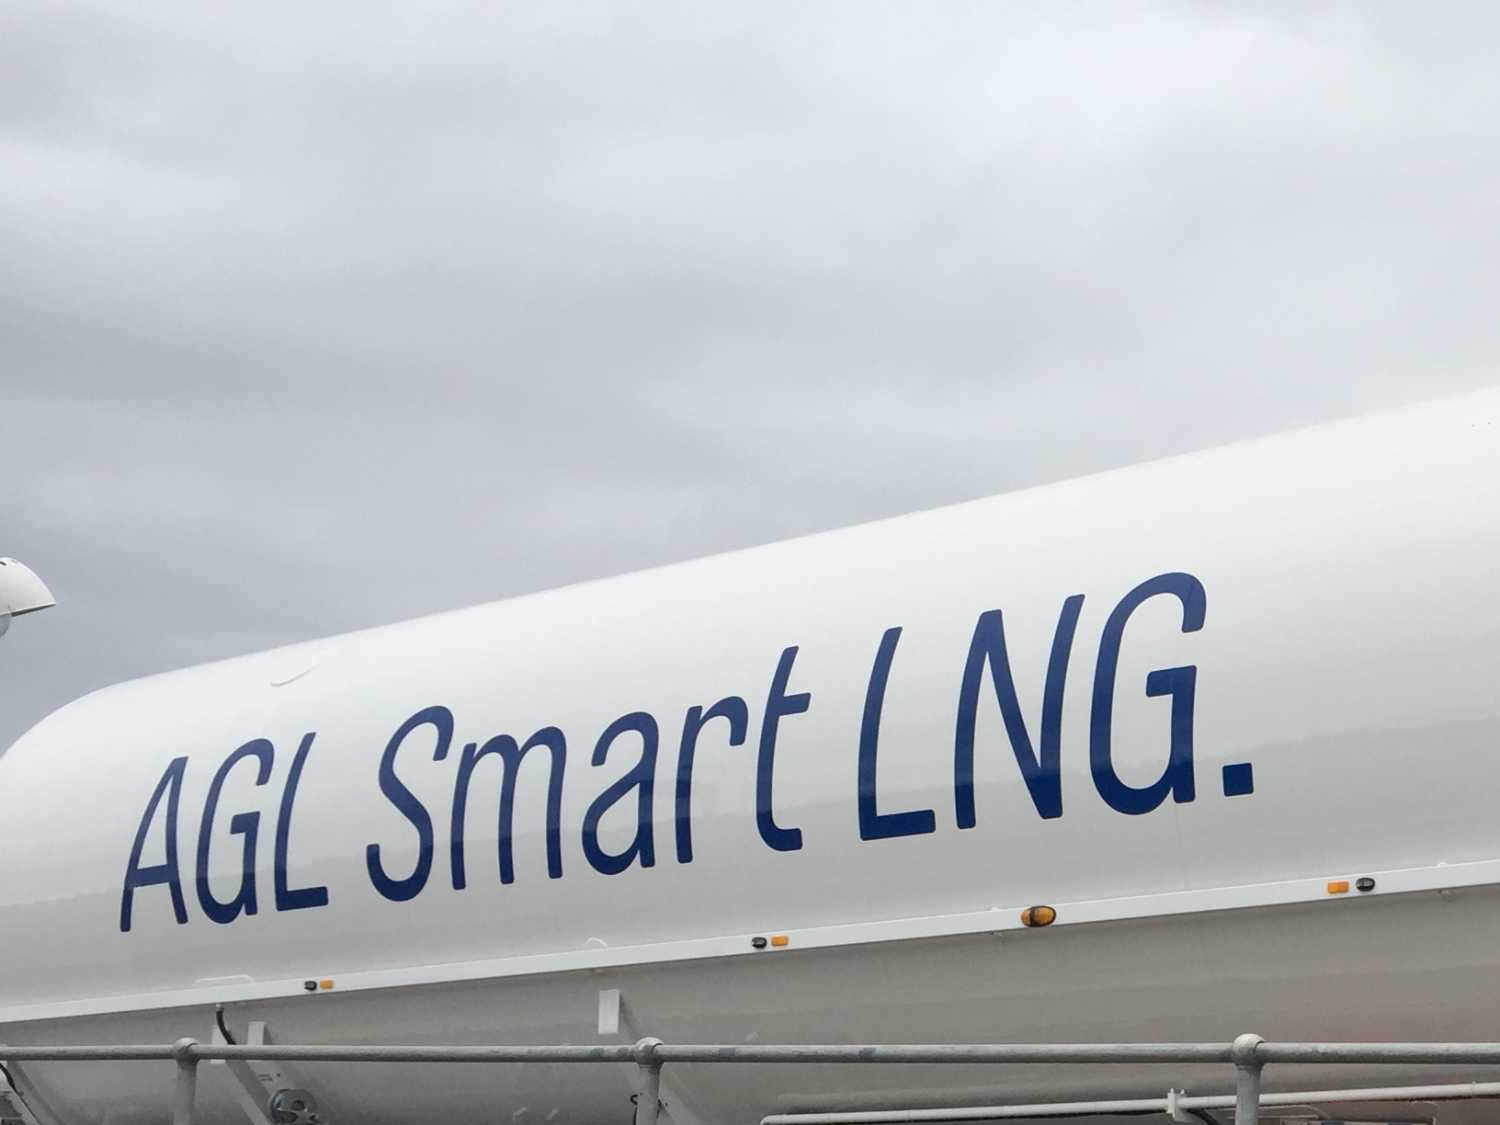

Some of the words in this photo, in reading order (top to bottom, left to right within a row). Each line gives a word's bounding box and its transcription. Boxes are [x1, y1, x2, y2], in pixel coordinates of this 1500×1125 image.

[120, 731, 330, 933] AGL
[365, 645, 810, 903] Smart
[857, 571, 1254, 841] LNG.
